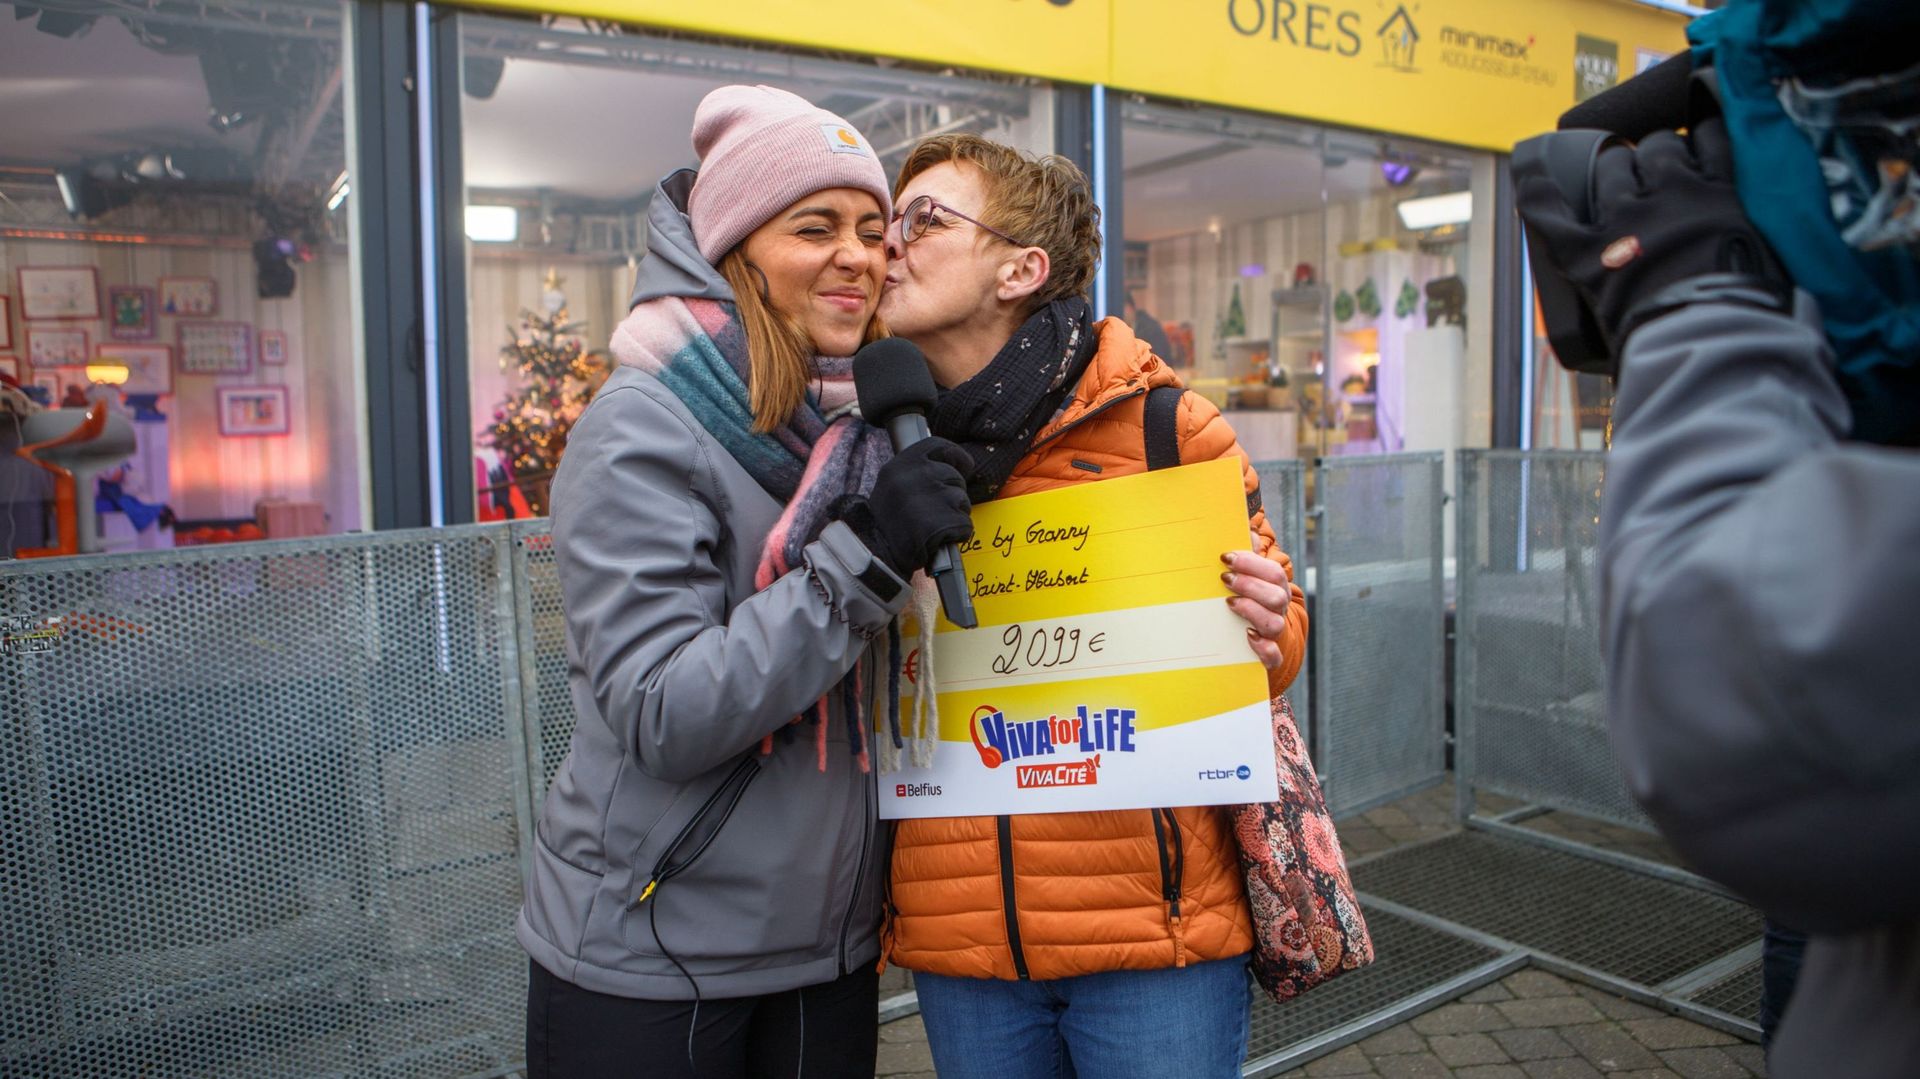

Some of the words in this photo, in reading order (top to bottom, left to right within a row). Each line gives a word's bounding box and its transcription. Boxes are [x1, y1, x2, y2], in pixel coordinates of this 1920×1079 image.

[1228, 0, 1361, 57] ORES
[1440, 26, 1528, 60] minimax
[992, 525, 1015, 558] by
[1026, 519, 1091, 551] Granny
[1050, 714, 1082, 745] for
[907, 782, 943, 798] Belfius
